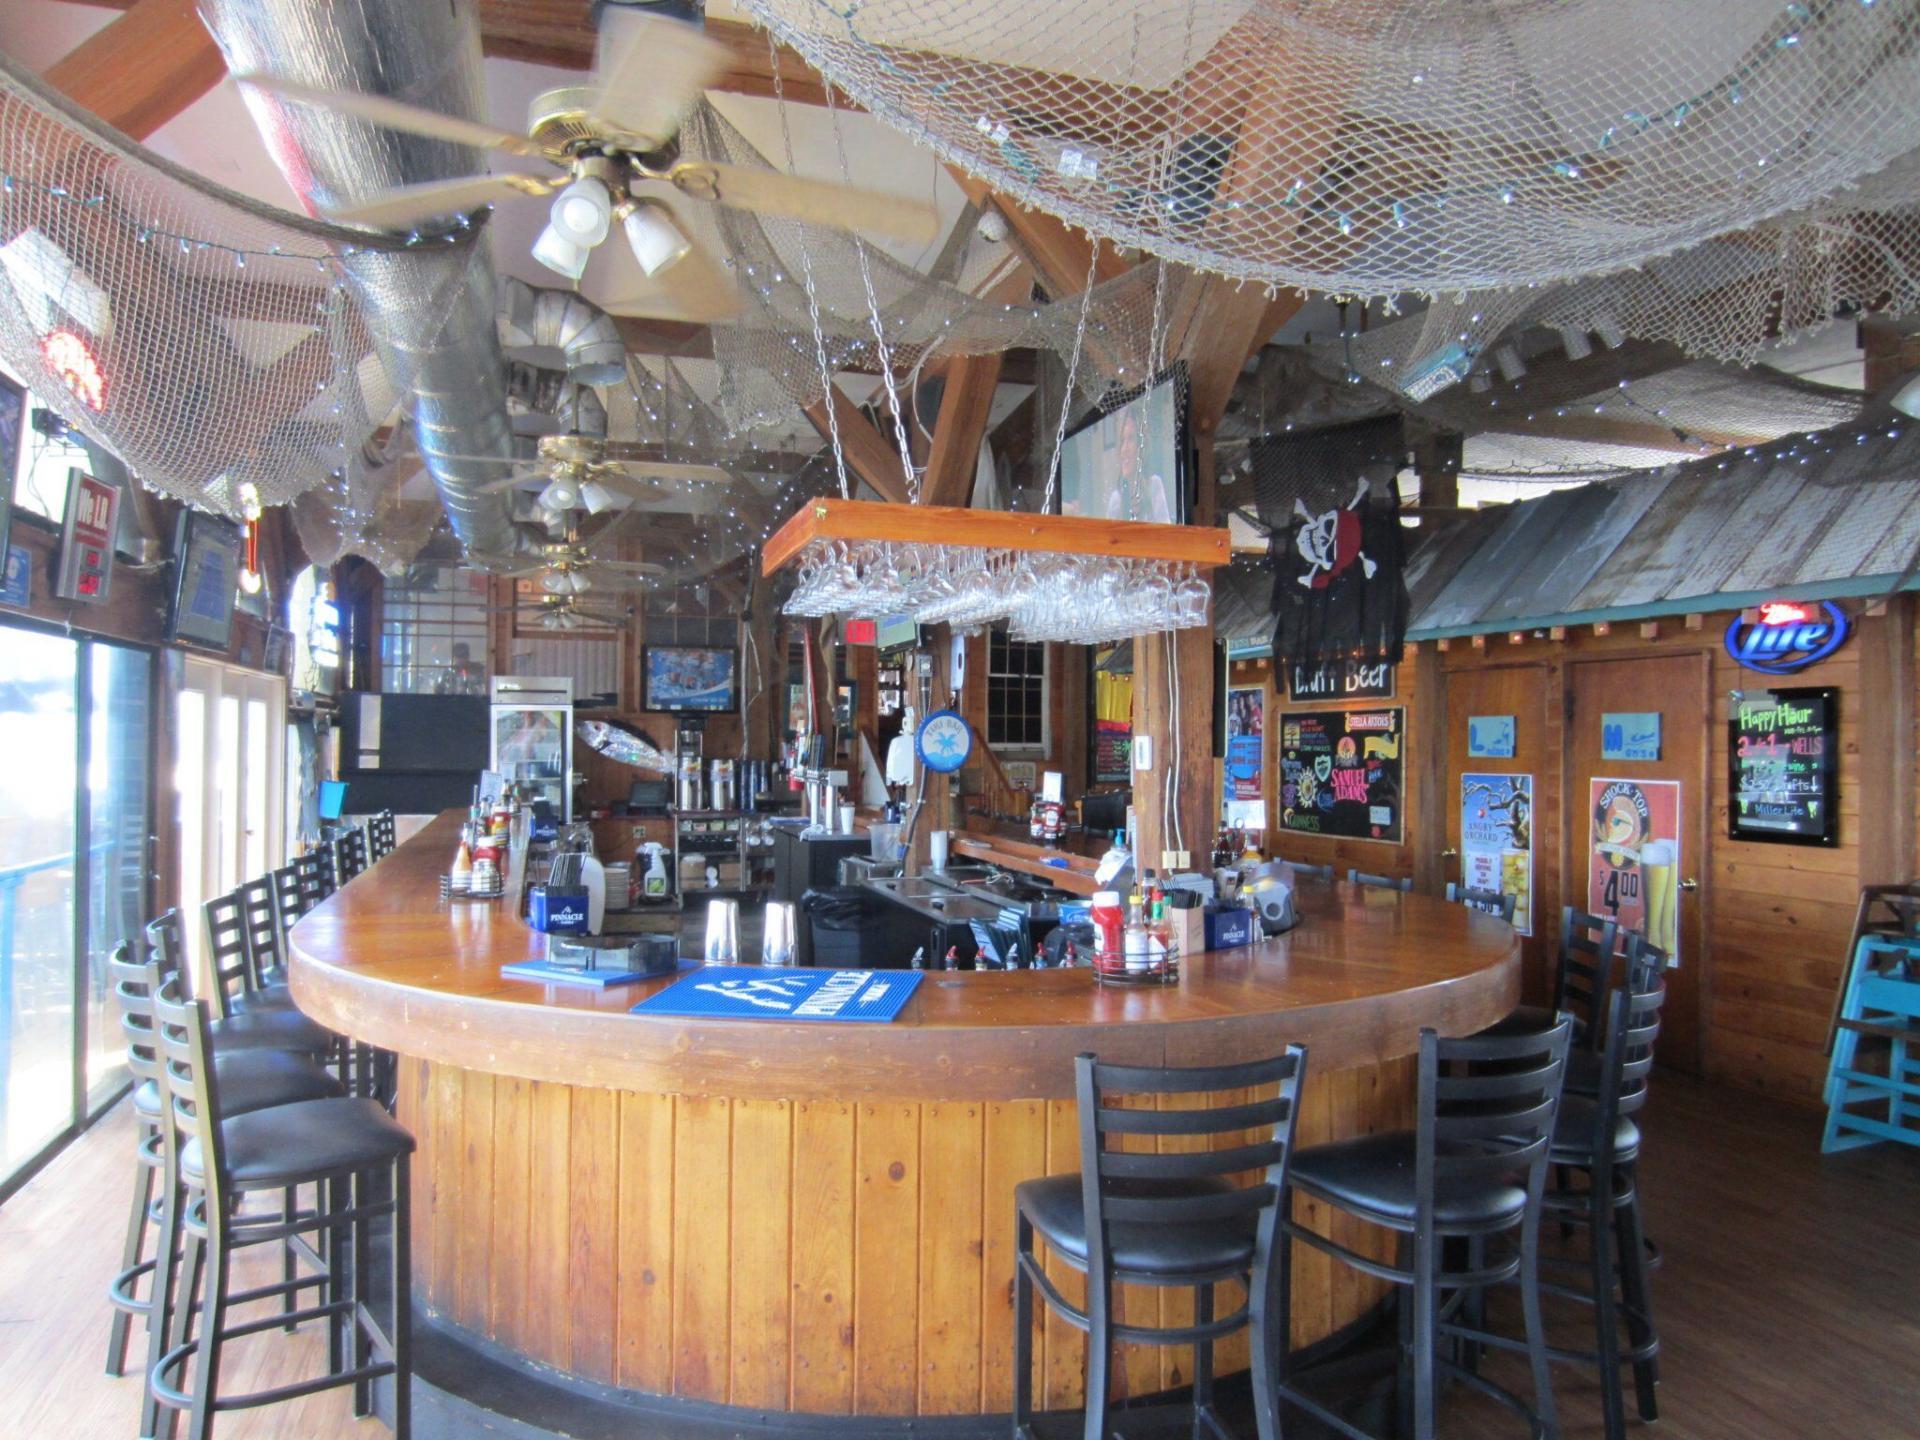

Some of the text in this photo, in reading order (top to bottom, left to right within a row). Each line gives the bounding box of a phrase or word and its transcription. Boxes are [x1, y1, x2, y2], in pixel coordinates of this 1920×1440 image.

[1738, 622, 1830, 660] Lite
[1345, 661, 1389, 693] Beer
[1739, 702, 1813, 732] Happy Hour
[1737, 735, 1753, 757] 2
[1791, 736, 1823, 755] WELLS
[1331, 768, 1366, 788] SAMUEL
[1334, 784, 1370, 805] ADAMS
[1599, 781, 1648, 818] SHOCK TOP
[1465, 831, 1498, 842] ORCHARD
[550, 913, 584, 922] PINNACLE
